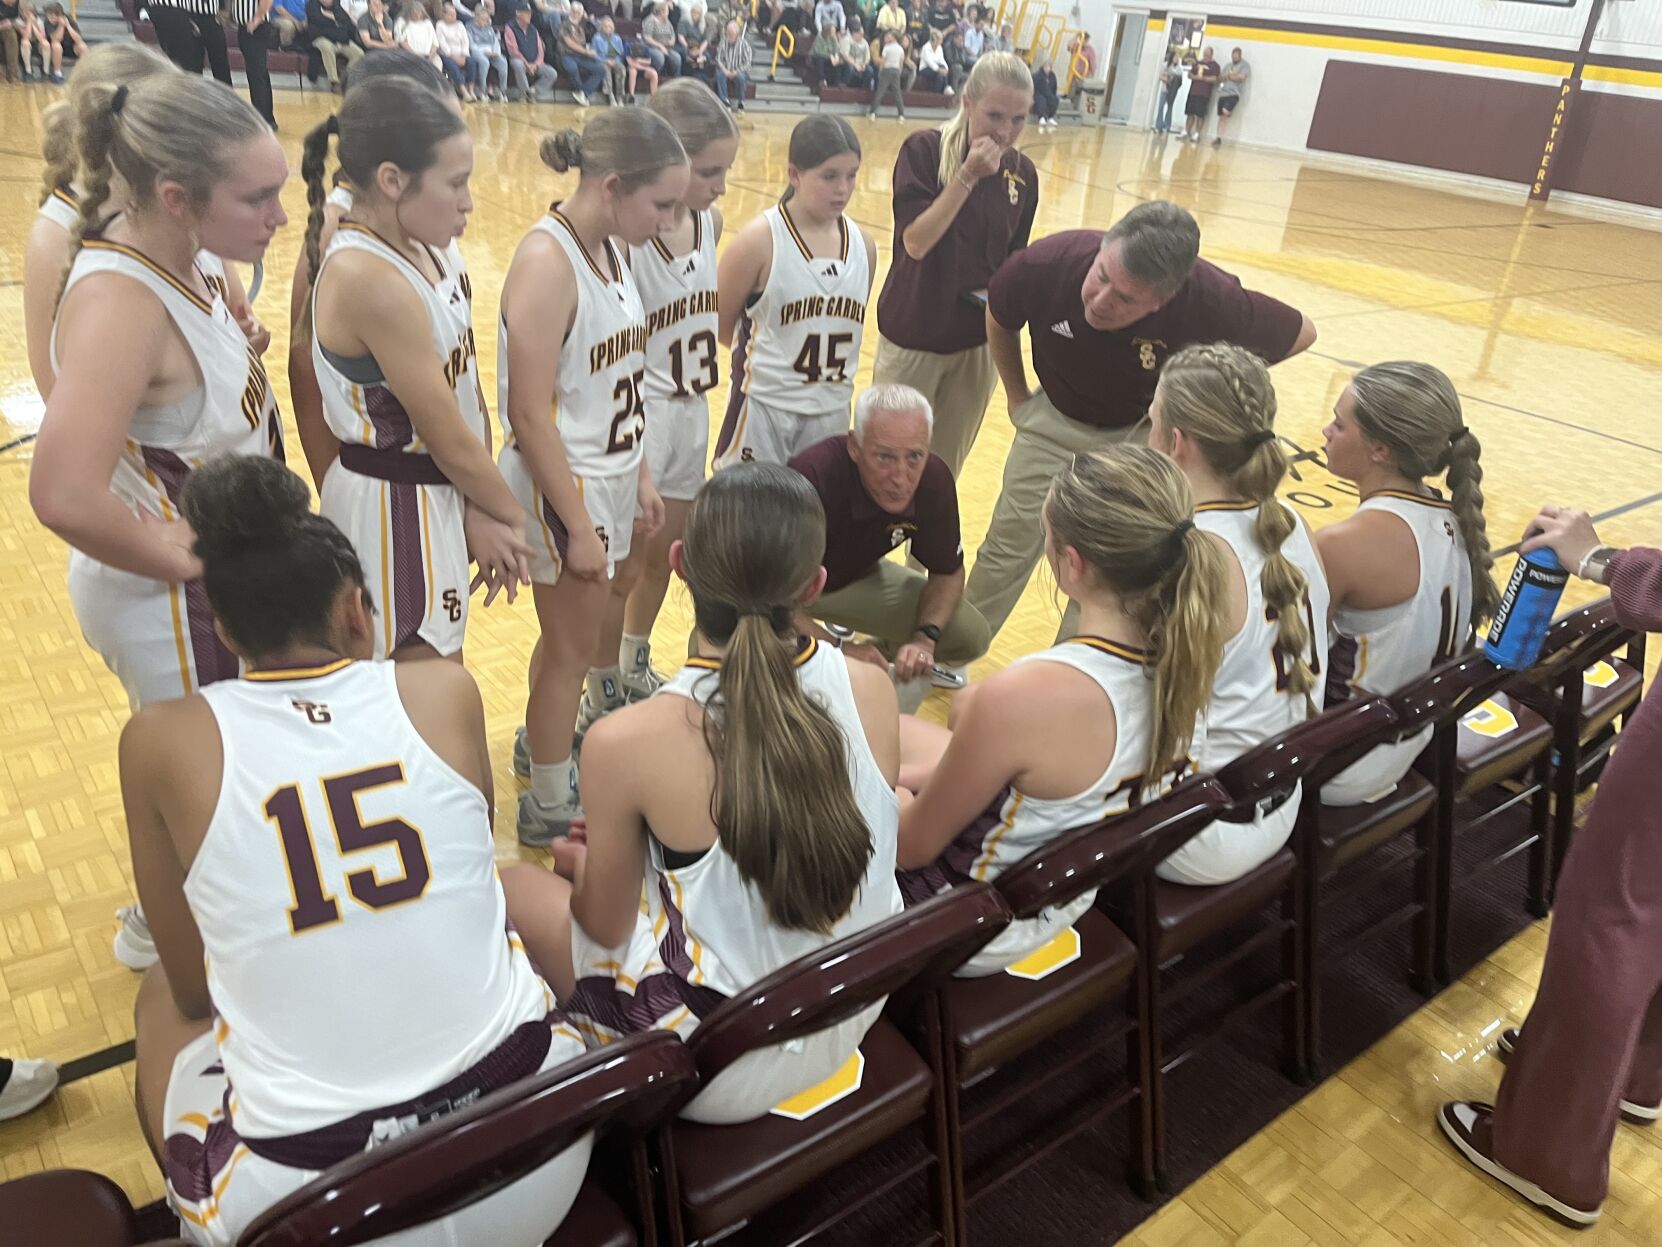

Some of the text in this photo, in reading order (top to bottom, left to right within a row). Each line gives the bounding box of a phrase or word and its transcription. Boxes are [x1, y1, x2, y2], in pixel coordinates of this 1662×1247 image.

[1532, 84, 1571, 194] PANTHERS
[780, 294, 825, 327] SPRING
[590, 325, 631, 376] SPRING
[668, 328, 720, 399] 13
[793, 331, 853, 384] 45
[442, 588, 462, 623] SG
[1489, 557, 1528, 643] POWERADE
[262, 759, 434, 937] 15
